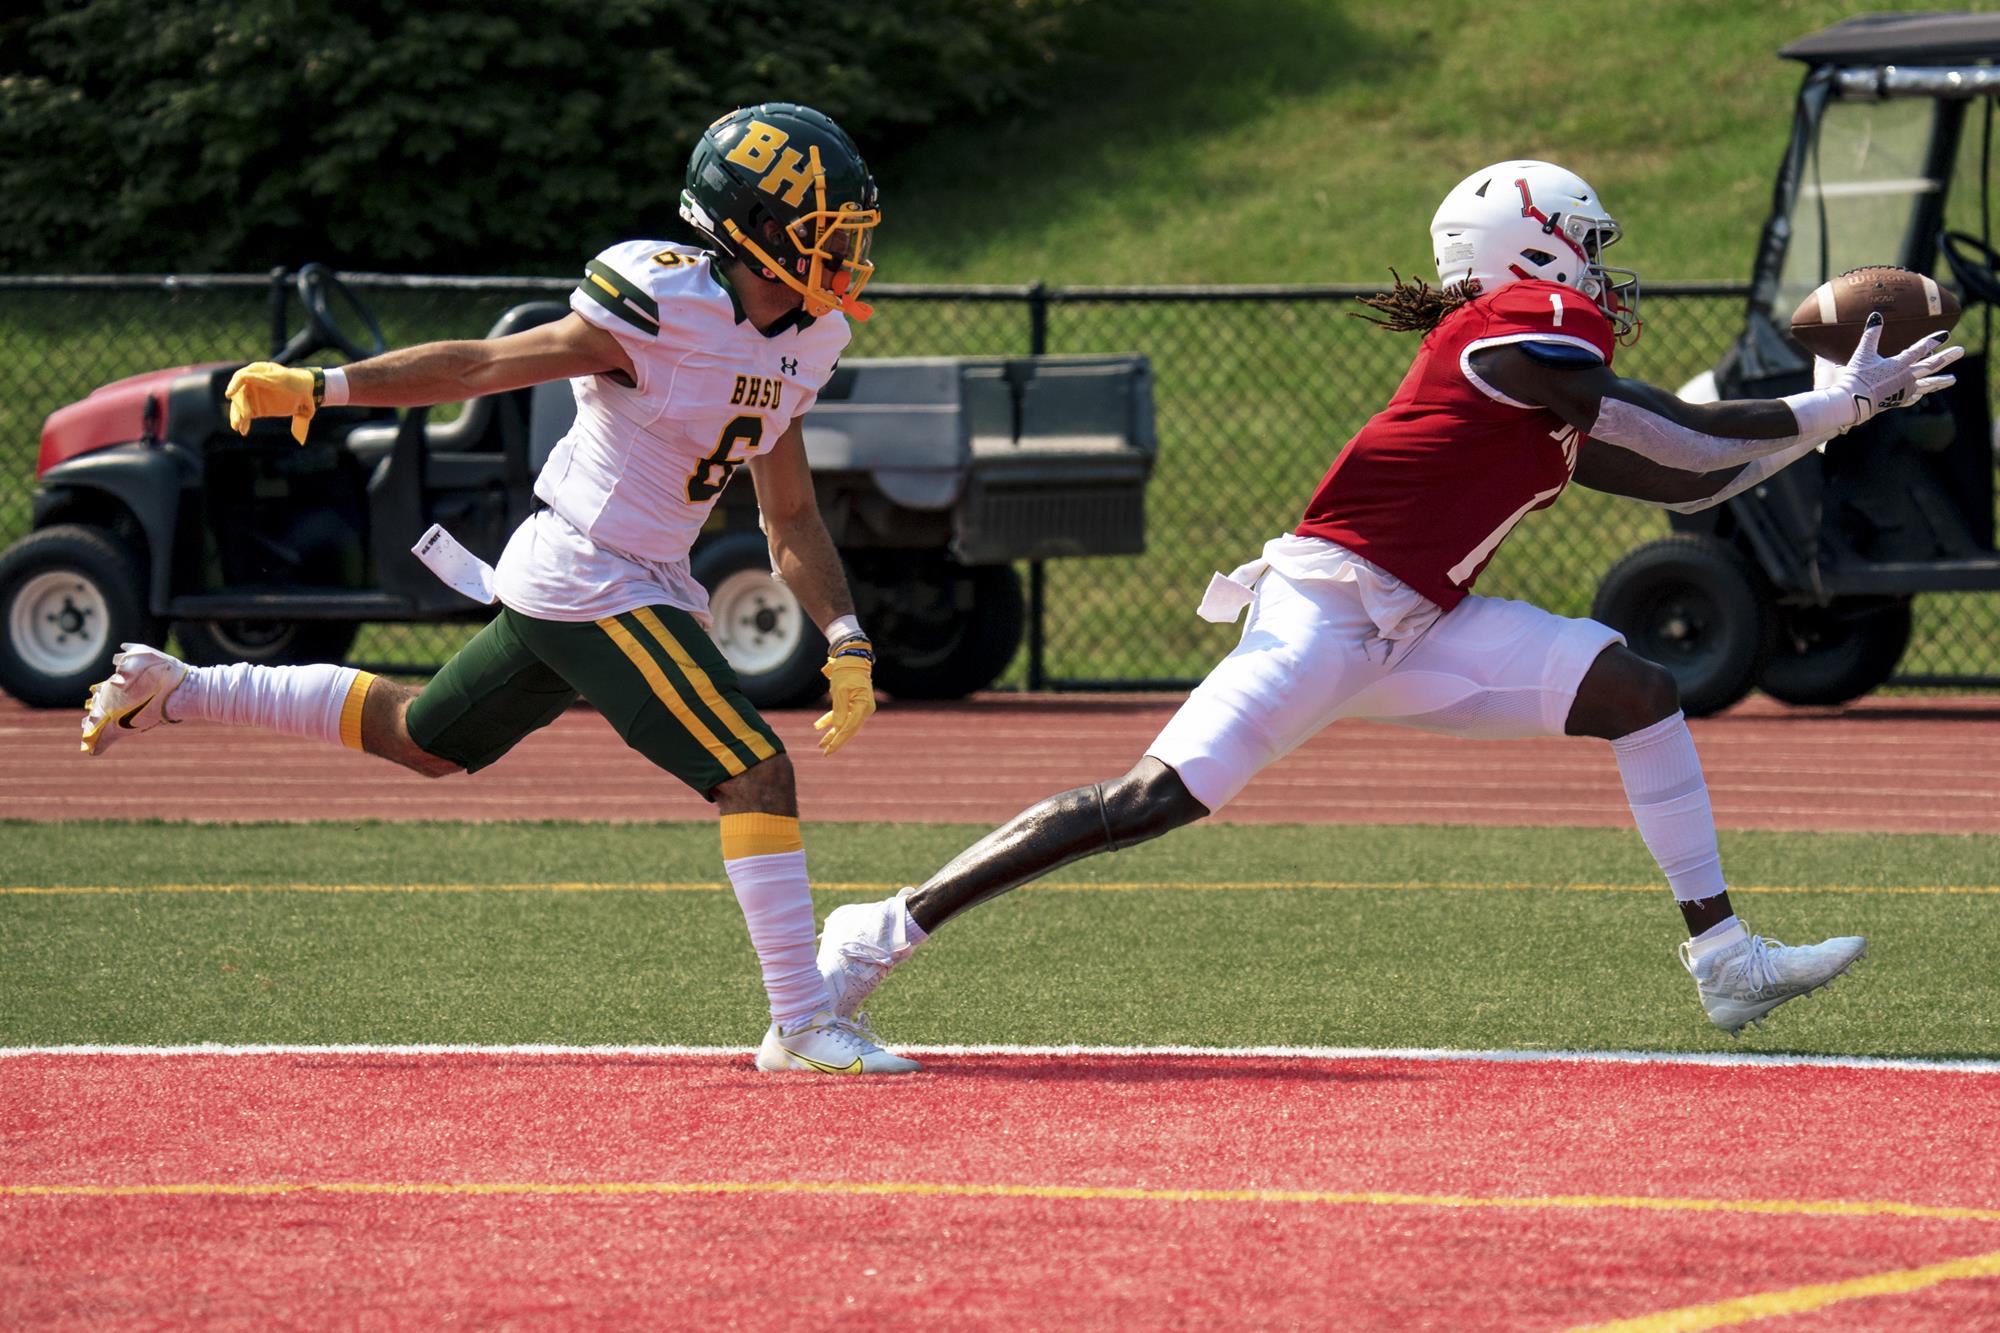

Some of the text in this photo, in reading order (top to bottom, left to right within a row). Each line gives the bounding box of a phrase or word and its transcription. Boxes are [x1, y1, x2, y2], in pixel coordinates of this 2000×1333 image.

[725, 119, 826, 208] BH
[1549, 293, 1564, 327] 1
[729, 372, 784, 410] BHSU
[684, 412, 765, 505] 6
